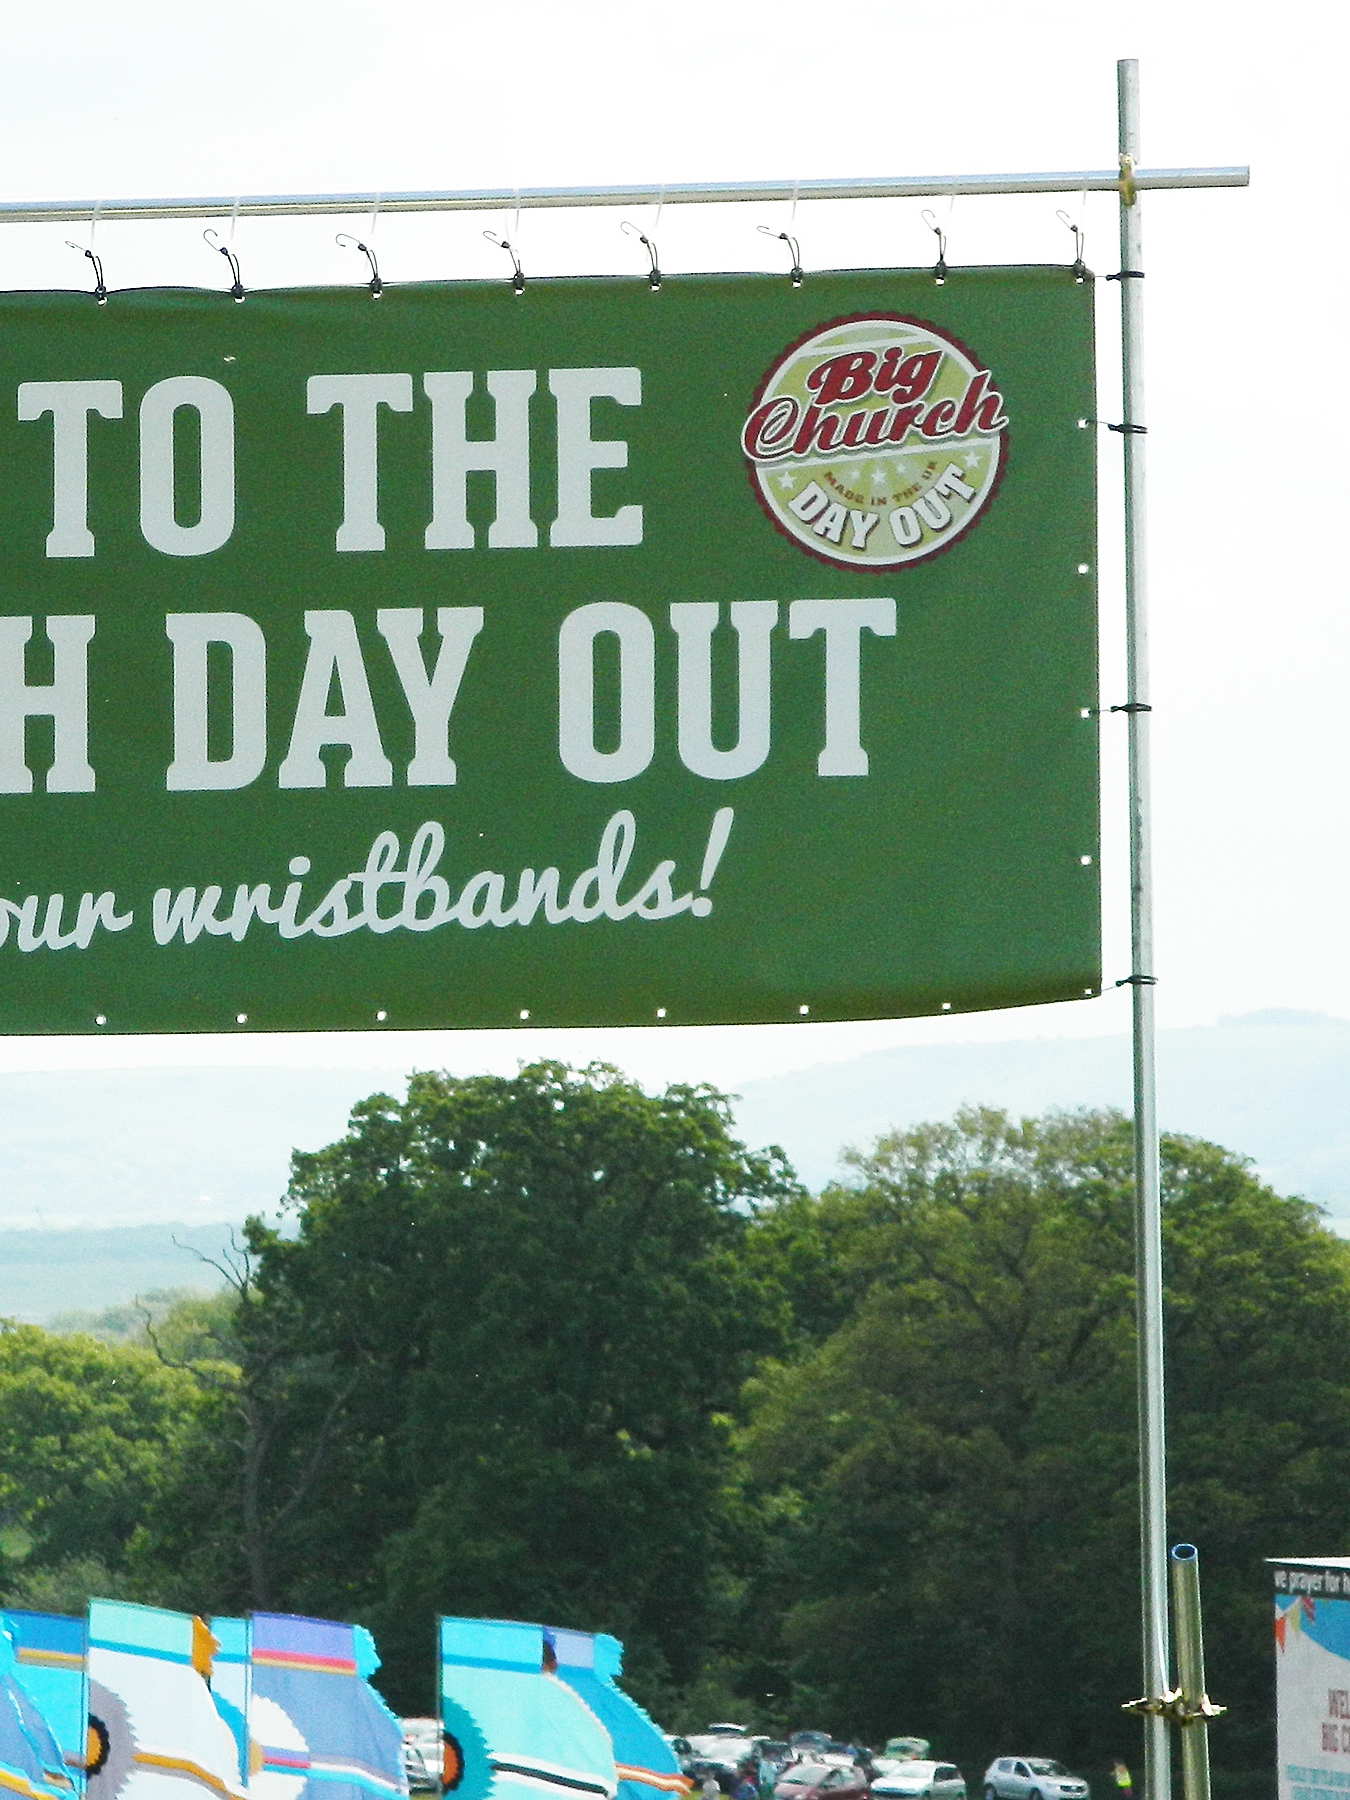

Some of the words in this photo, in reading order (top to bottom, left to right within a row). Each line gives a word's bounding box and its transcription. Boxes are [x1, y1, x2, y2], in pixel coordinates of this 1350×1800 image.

[742, 370, 1008, 460] Church
[806, 347, 944, 404] Big
[18, 376, 236, 558] TO
[307, 367, 644, 552] THE
[788, 481, 879, 549] DAY
[888, 463, 976, 546] OUT
[165, 606, 485, 792] DAY
[558, 597, 897, 784] OUT
[152, 807, 735, 946] wristbands!
